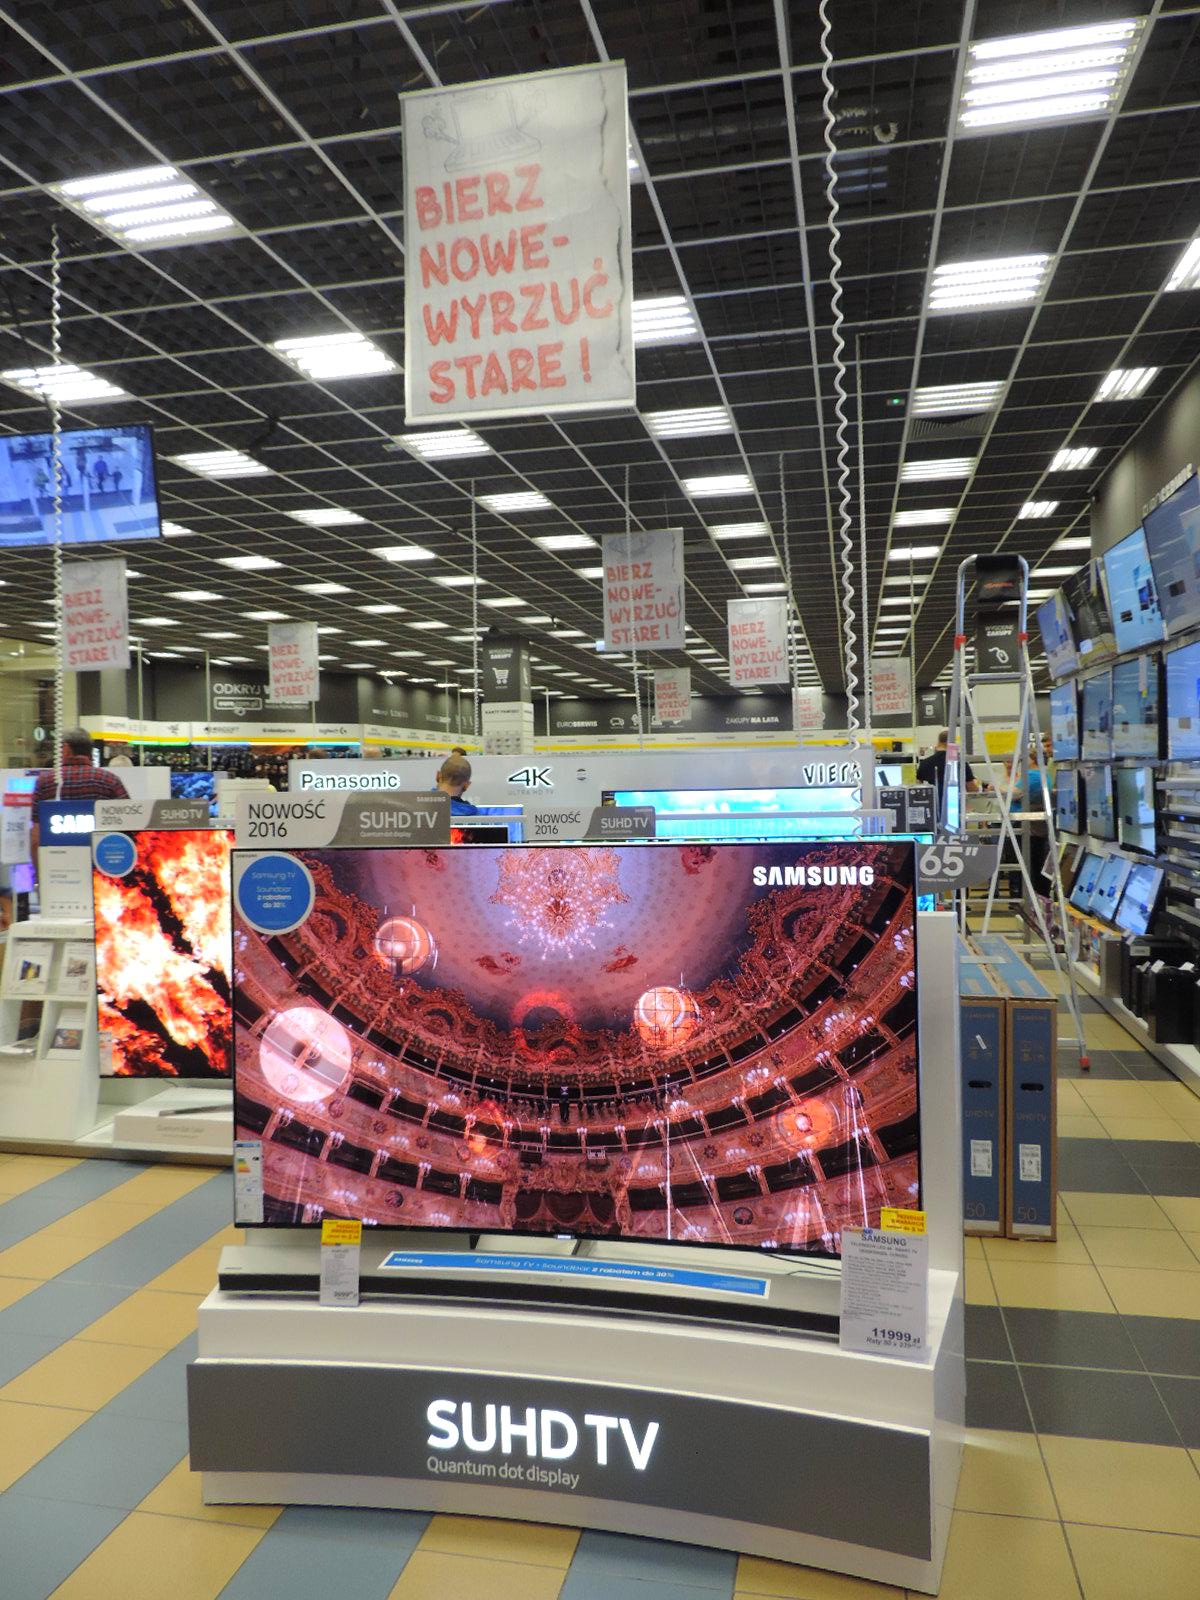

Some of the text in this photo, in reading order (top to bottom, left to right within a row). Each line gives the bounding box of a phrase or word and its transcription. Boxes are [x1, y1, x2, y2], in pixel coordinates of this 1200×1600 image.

[415, 163, 544, 231] BIERZ
[420, 223, 569, 288] NOWE-
[422, 257, 613, 346] WYRZUĆ
[429, 341, 566, 404] STARE
[607, 561, 653, 583] BIERZ
[64, 588, 103, 608] BIERZ
[611, 624, 660, 644] STARE
[730, 621, 766, 636] BIERZ
[69, 647, 109, 665] STARE
[735, 666, 770, 680] STARE
[213, 683, 260, 694] ODKRYJ
[274, 685, 304, 697] STARE
[301, 771, 400, 789] Panasonic
[508, 767, 553, 787] 4K
[248, 798, 326, 819] NOWOŚĆ
[534, 811, 581, 824] NOWOŚĆ
[360, 811, 438, 829] SUHD TV
[601, 818, 648, 829] SUHD TV
[248, 822, 288, 838] 2016
[535, 825, 559, 835] 2016
[920, 846, 979, 876] 65"
[252, 871, 286, 880] Samsung
[753, 866, 874, 886] SAMSUNG
[861, 1233, 907, 1246] SAMSUNG
[475, 1257, 520, 1267] Samsung
[523, 1260, 534, 1268] TV
[599, 1267, 640, 1277] rabatem
[872, 1328, 911, 1342] 11999
[426, 1399, 660, 1471] SUHD TV
[427, 1456, 580, 1489] Quantum dot display
